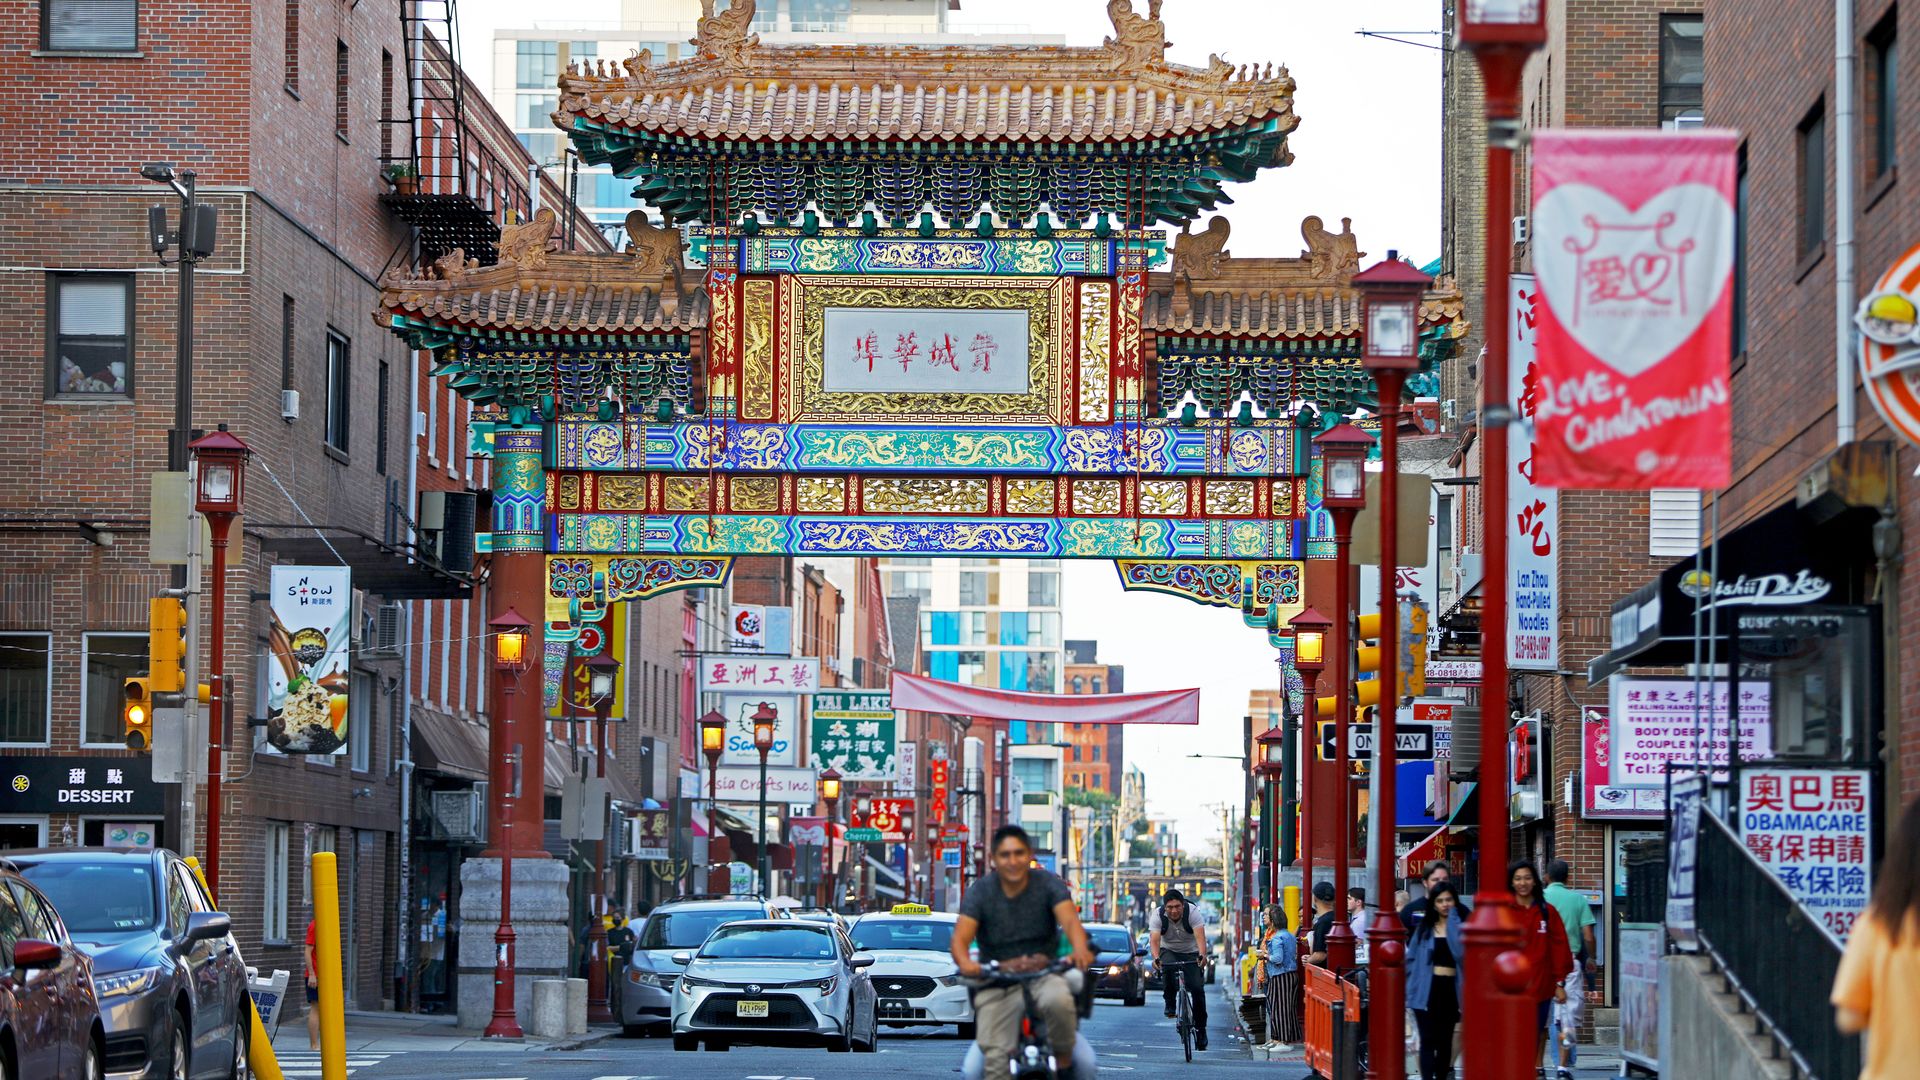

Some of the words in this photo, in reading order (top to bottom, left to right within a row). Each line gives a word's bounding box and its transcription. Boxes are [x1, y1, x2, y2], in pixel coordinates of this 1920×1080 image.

[1517, 570, 1530, 588] Lan
[1531, 570, 1549, 588] Zhou
[1516, 591, 1551, 609] Hand-Pulled
[1518, 613, 1549, 630] Noodles
[816, 695, 842, 710] TAI
[849, 695, 891, 710] LAKE
[1635, 728, 1669, 737] BODY
[1673, 728, 1705, 737] DEEP
[1637, 740, 1686, 749] COUPLE
[1690, 740, 1753, 749] MASSGE
[58, 789, 135, 803] DESSERT
[1746, 774, 1865, 813] 奧巴馬
[1745, 813, 1866, 831] OBAMACARE
[844, 832, 870, 841] Cherry
